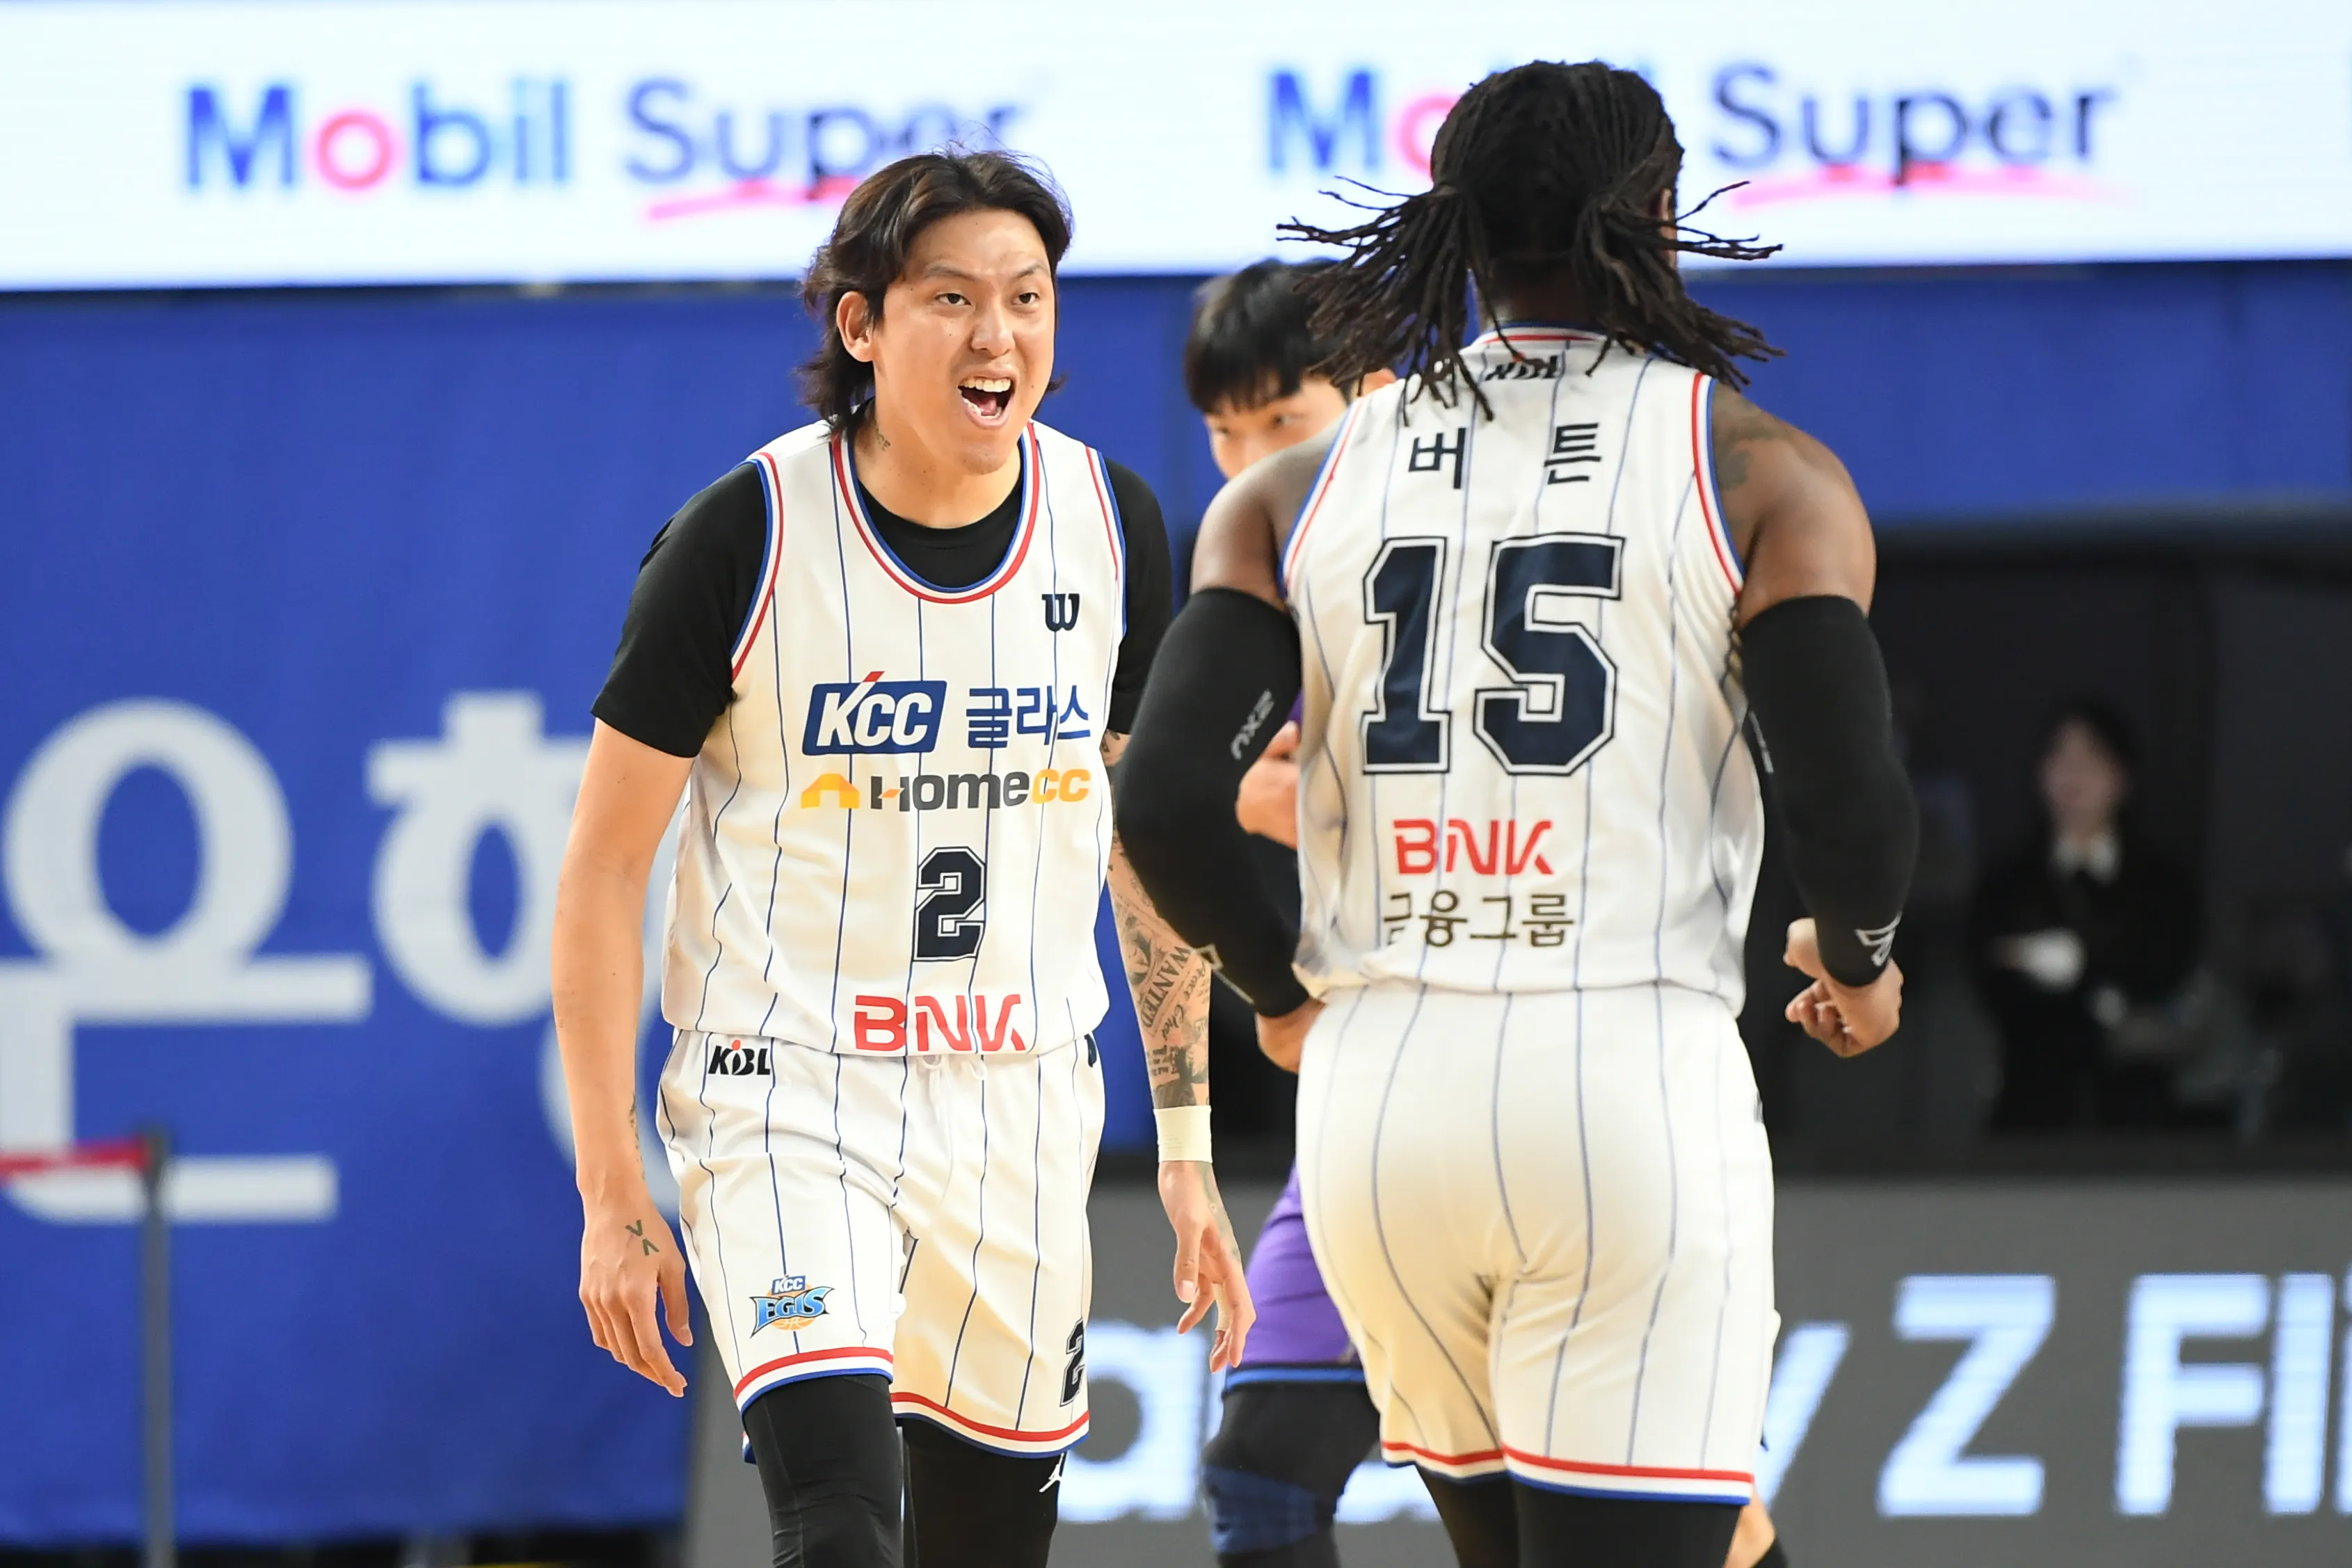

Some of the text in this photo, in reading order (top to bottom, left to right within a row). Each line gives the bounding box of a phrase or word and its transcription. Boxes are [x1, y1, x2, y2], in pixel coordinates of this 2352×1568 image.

[184, 78, 570, 188] Mobil
[1711, 63, 2119, 185] Super
[1360, 531, 1626, 776] 15
[814, 671, 1091, 749] KCC 글라스
[1393, 818, 1555, 876] BNK
[912, 846, 986, 963] 2
[854, 993, 1026, 1052] BNK
[1139, 945, 1192, 1029] WANTED
[707, 1039, 771, 1076] KBL
[750, 1286, 834, 1338] EGIS
[773, 1274, 804, 1295] KCC
[1877, 1273, 2058, 1519] Z
